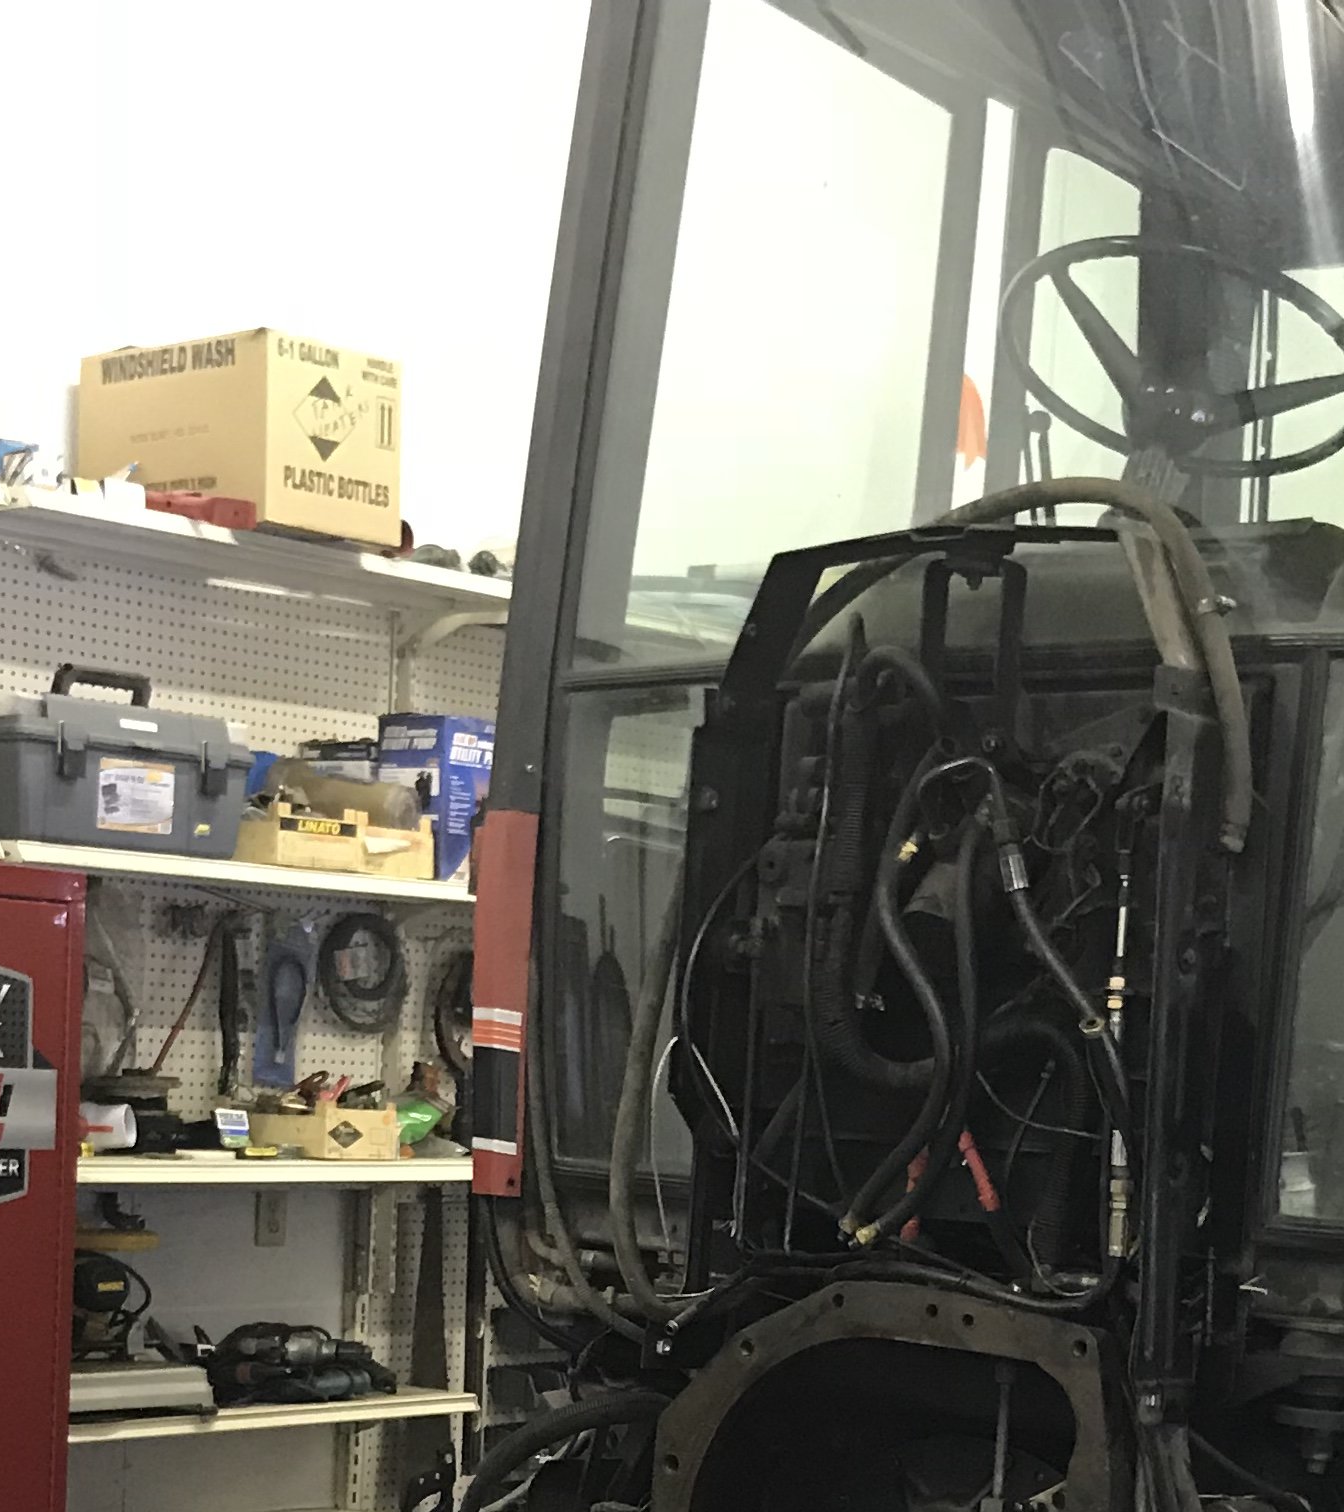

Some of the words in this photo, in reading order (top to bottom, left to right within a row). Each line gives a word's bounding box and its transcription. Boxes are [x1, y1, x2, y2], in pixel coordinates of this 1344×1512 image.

[101, 346, 188, 385] WINDSHIELD
[191, 338, 236, 371] WASH
[298, 342, 339, 369] GALLON
[283, 465, 335, 497] PLASTIC
[337, 475, 390, 508] BOTTLES
